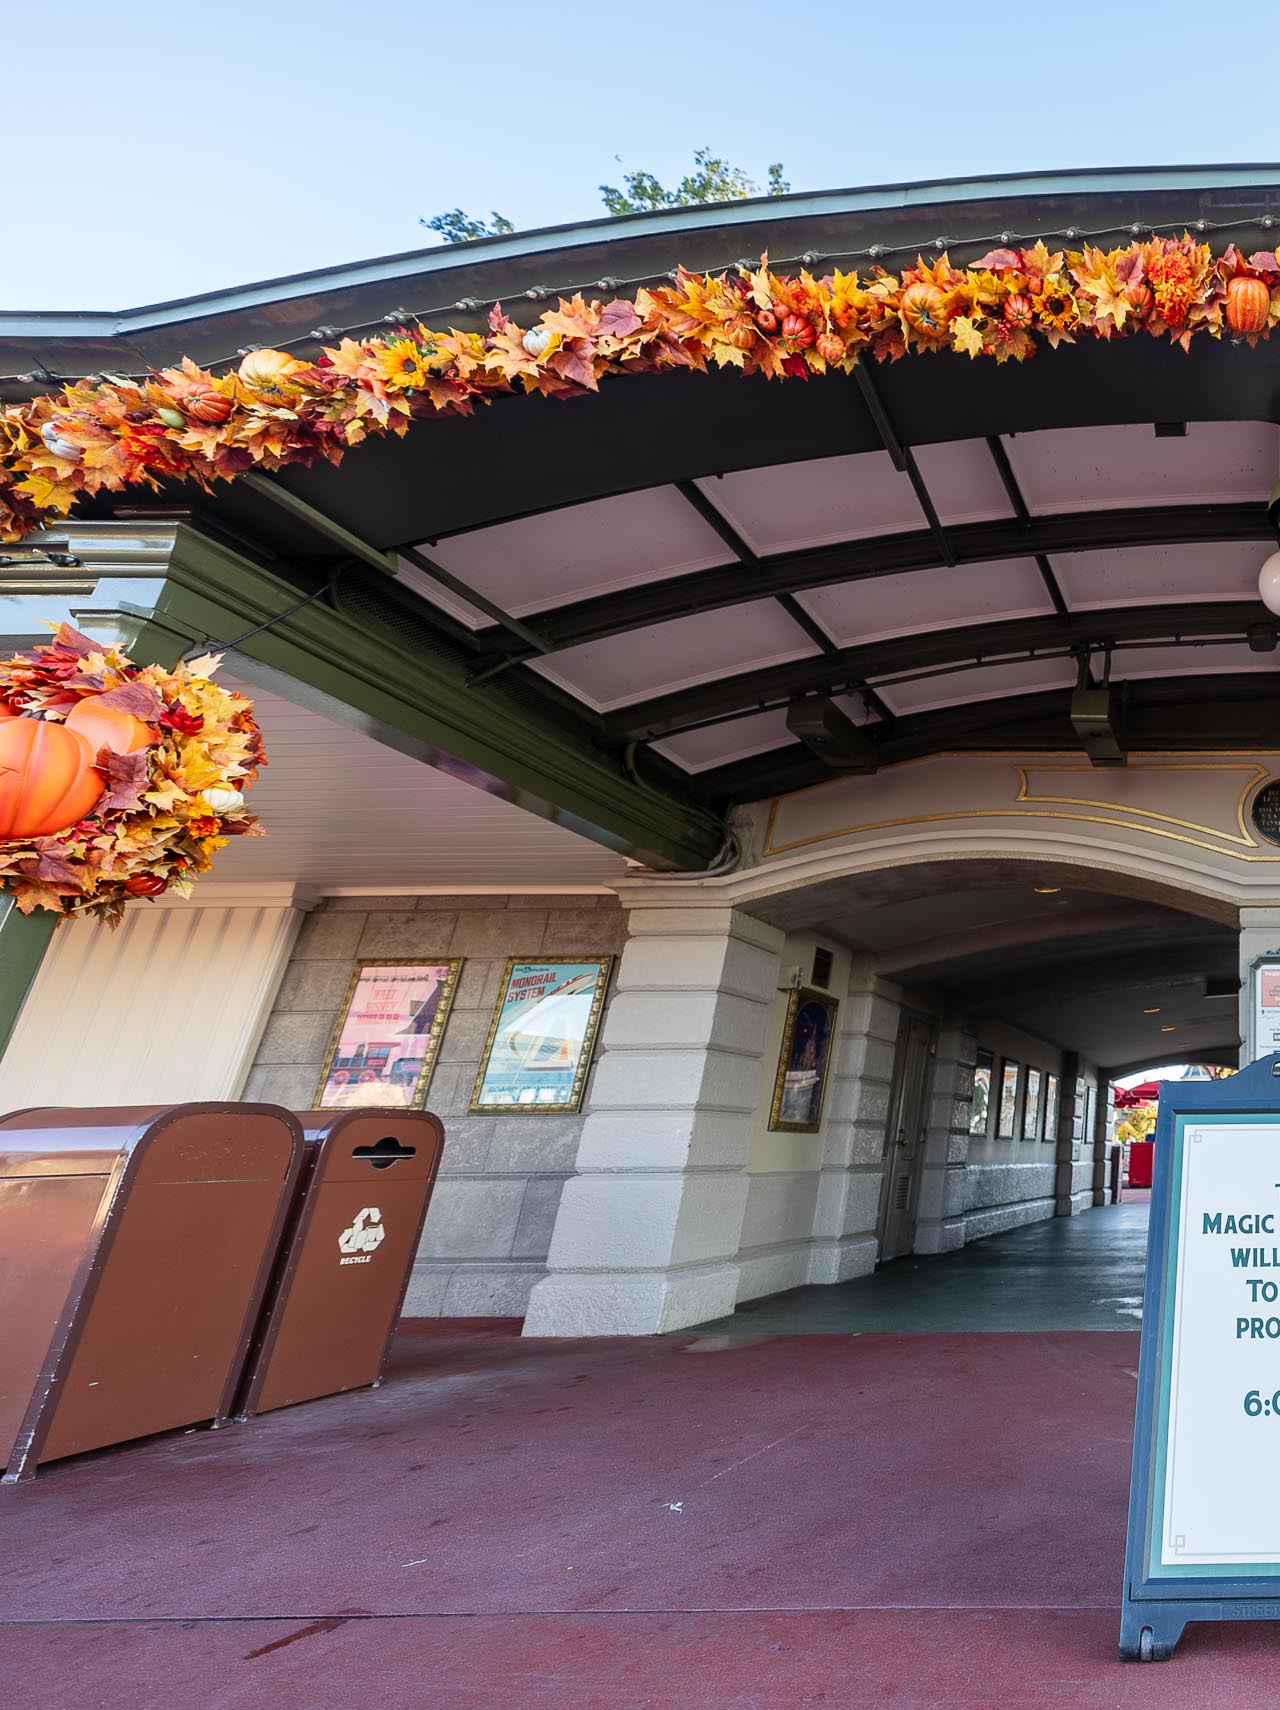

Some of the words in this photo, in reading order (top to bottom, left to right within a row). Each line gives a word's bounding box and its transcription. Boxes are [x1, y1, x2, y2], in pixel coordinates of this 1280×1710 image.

[511, 972, 556, 989] MONORAIL
[507, 986, 546, 1003] SYSTEM
[1202, 1212, 1274, 1234] MAGIC
[340, 1255, 372, 1265] RECYCLE
